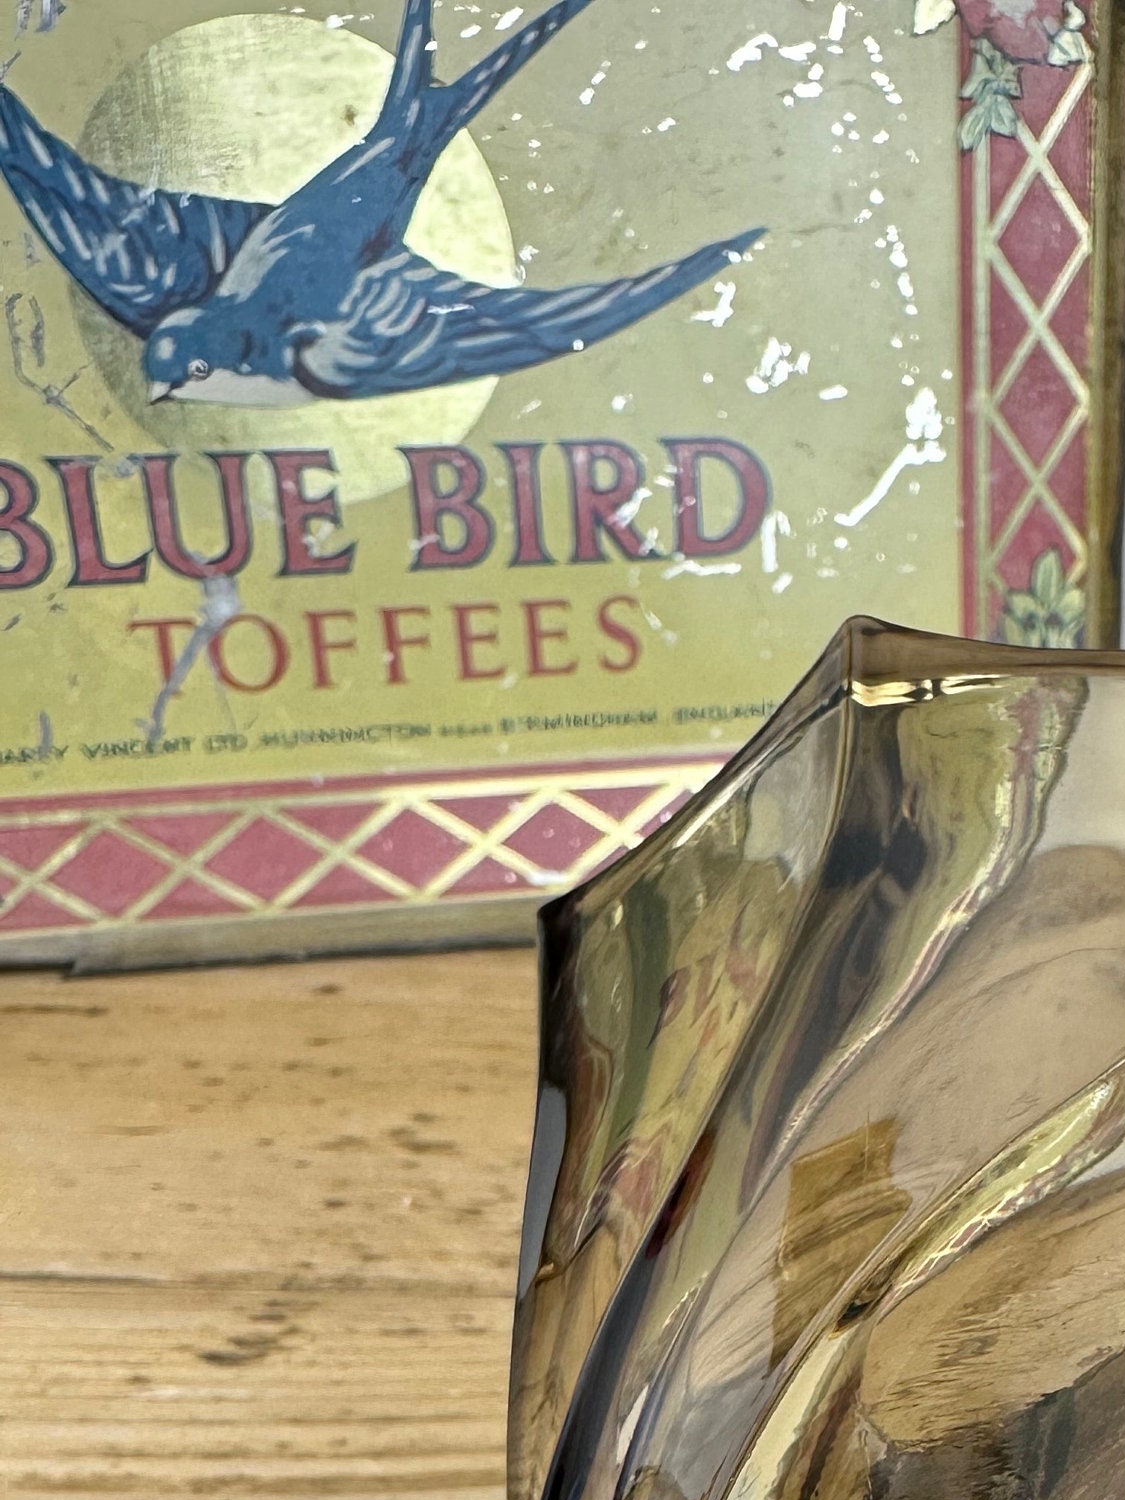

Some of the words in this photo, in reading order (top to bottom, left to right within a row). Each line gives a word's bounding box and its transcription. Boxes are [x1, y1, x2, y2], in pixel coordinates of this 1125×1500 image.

[0, 447, 357, 590] BLUE
[396, 436, 772, 572] BIRD
[126, 596, 645, 697] TOFFEES
